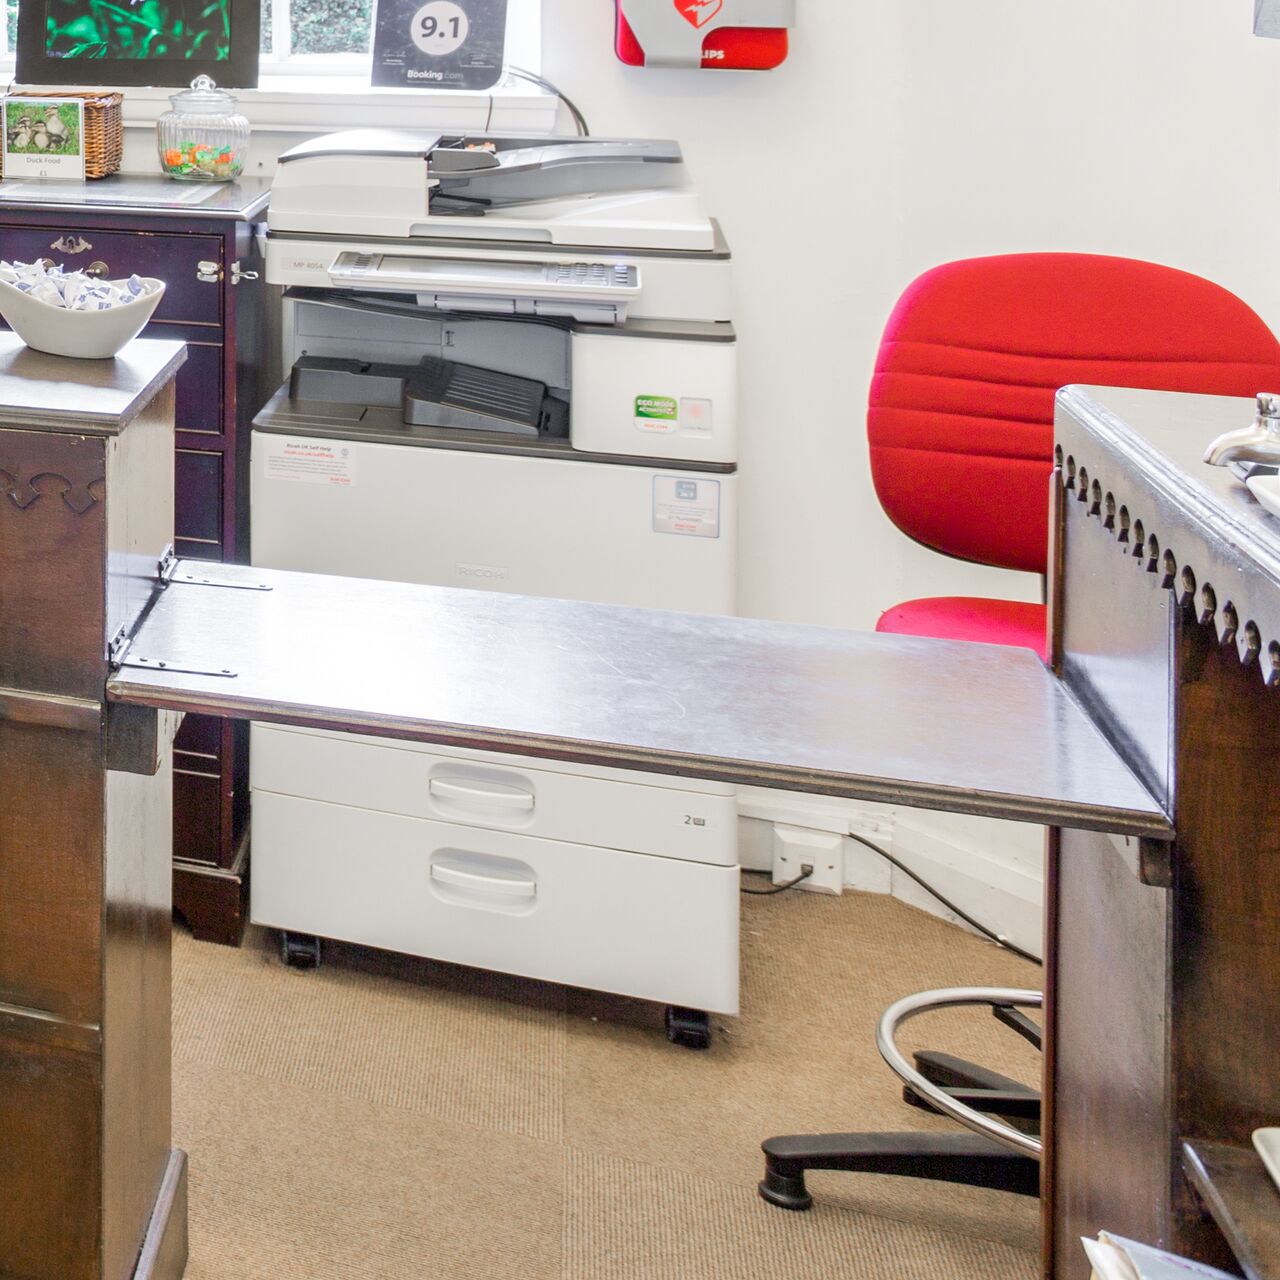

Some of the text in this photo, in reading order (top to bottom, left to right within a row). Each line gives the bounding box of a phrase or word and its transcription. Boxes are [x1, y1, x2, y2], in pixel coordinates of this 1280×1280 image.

[420, 16, 460, 38] 9.1
[458, 567, 505, 579] RICOH
[684, 814, 692, 825] 2
